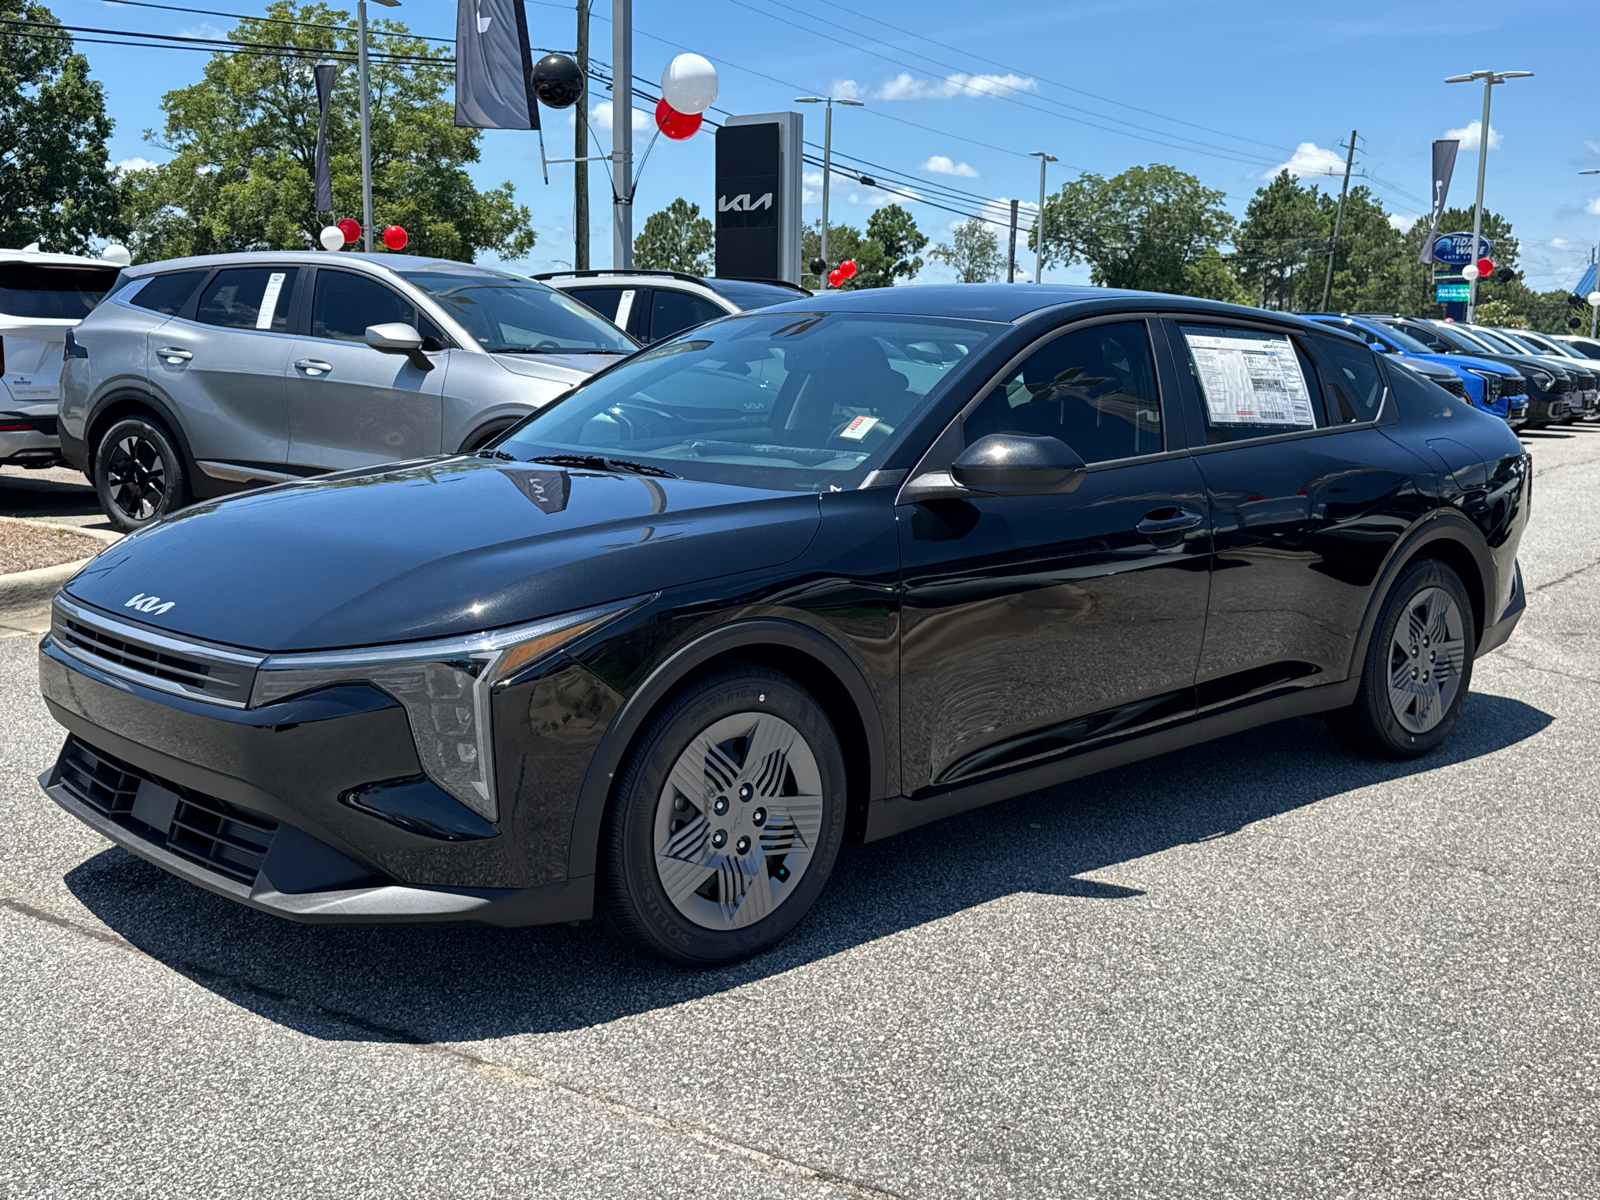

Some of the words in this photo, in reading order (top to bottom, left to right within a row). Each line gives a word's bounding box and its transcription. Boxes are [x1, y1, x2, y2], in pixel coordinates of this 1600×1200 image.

[718, 192, 773, 212] KIA
[1452, 237, 1474, 246] TIDA
[1456, 246, 1485, 254] WAE
[124, 592, 176, 616] KIA
[726, 690, 747, 702] R16
[818, 792, 842, 876] KUMHO
[642, 887, 693, 946] SOLUS
